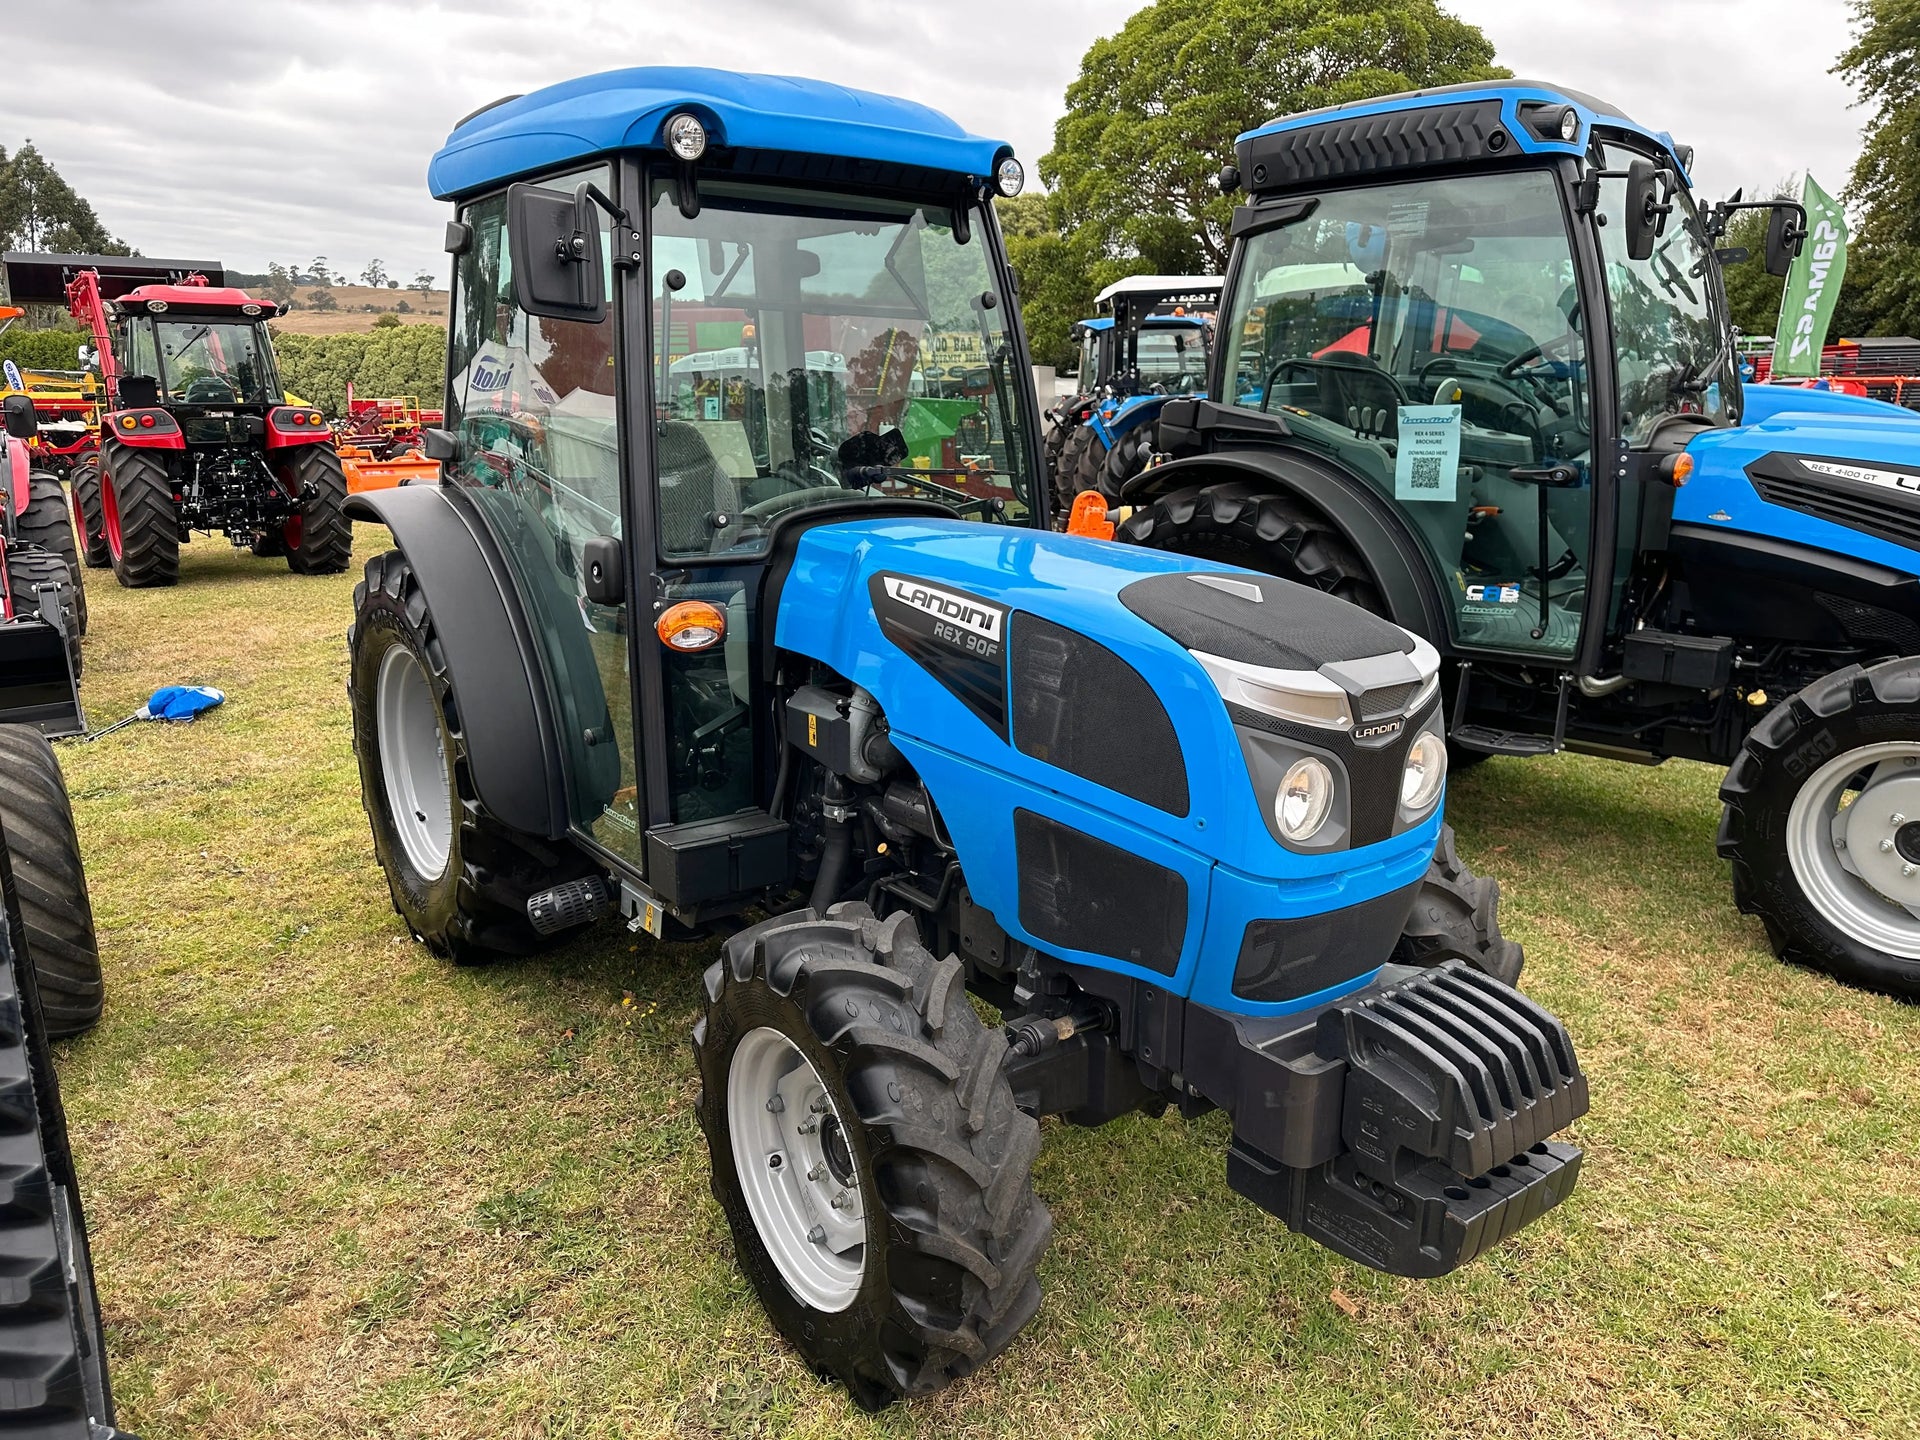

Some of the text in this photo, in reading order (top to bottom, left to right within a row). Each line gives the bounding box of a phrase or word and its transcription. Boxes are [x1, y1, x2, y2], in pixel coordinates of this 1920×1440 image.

[1811, 463, 1832, 473] REX
[1863, 473, 1878, 481] GT
[895, 582, 995, 631] LANDINI
[934, 621, 998, 657] REX 90F
[1355, 721, 1400, 738] LANDINI
[1783, 727, 1838, 778] BKT
